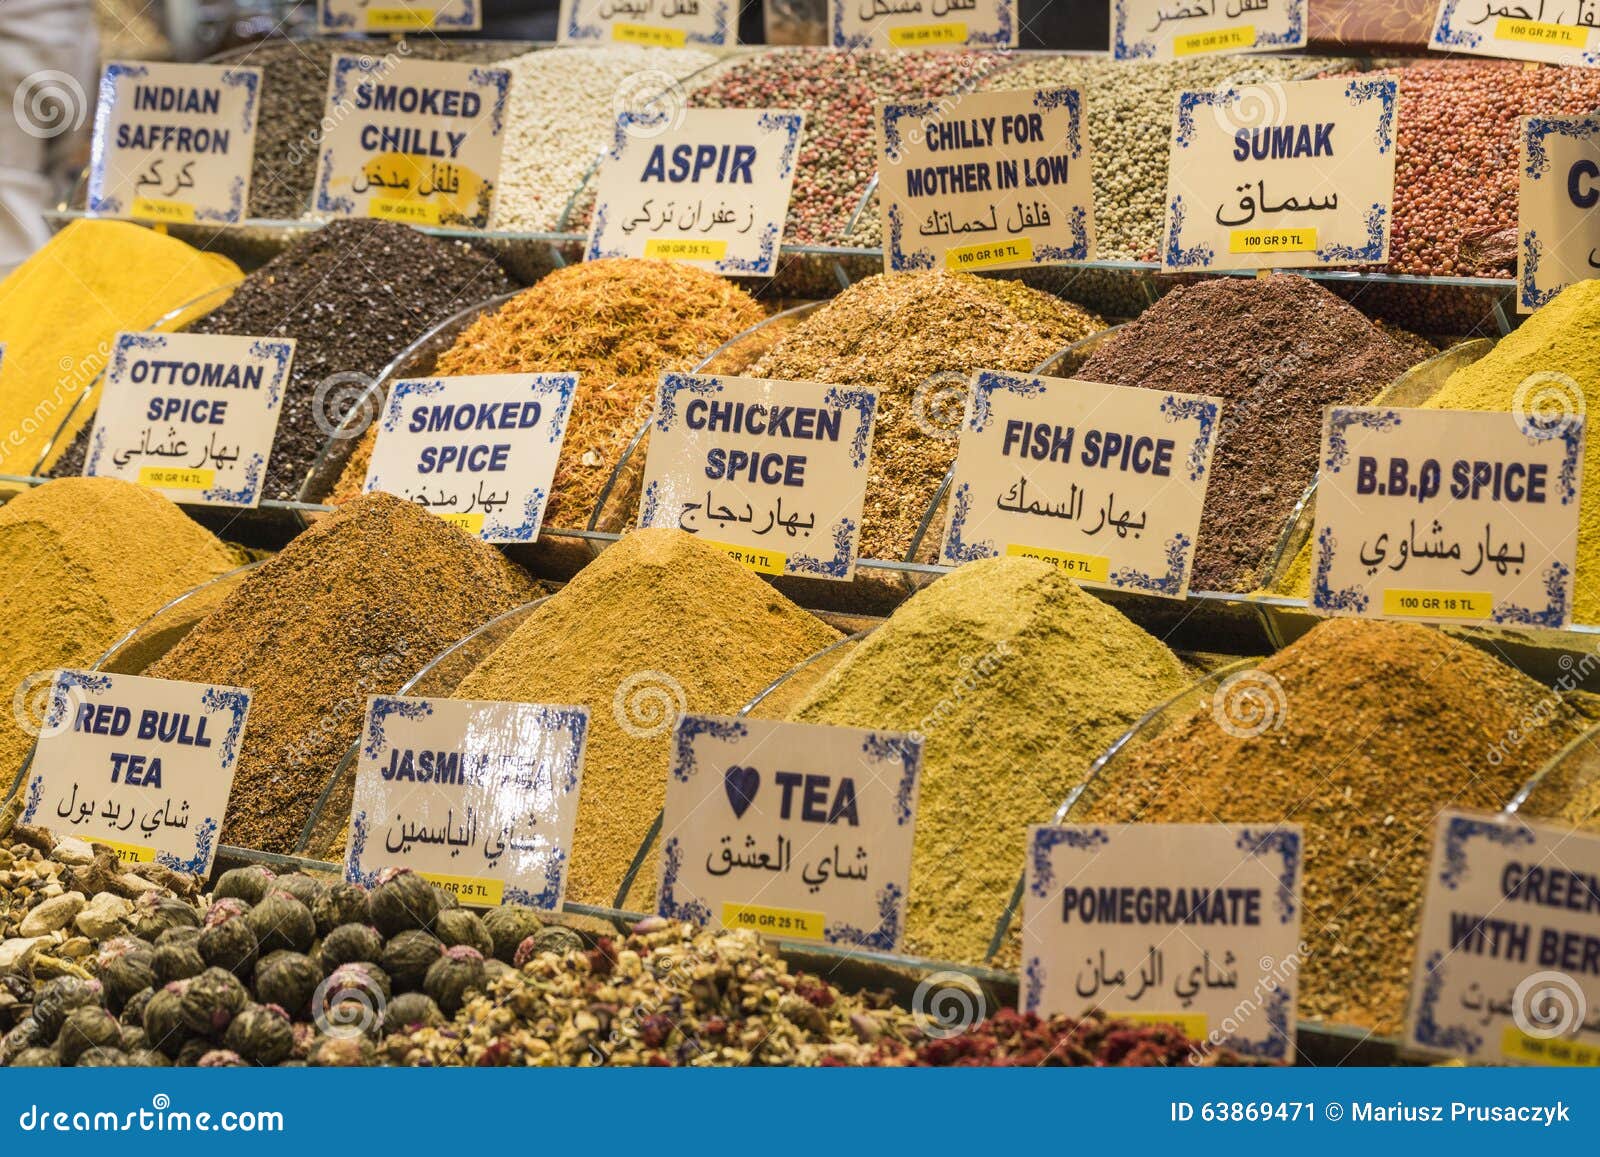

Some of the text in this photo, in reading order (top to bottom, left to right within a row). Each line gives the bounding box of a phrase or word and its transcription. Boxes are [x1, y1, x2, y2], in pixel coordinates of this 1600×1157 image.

[1186, 39, 1200, 49] 100
[1203, 37, 1216, 46] GR
[1231, 33, 1242, 43] TL
[1510, 25, 1526, 35] 100
[1529, 27, 1543, 38] GR
[1560, 31, 1572, 41] TL
[134, 85, 220, 114] INDIAN
[356, 83, 481, 119] SMOKED
[117, 124, 229, 155] SAFFRON
[361, 124, 466, 158] CHILLY
[926, 112, 1044, 152] CHILLY FOR
[1233, 122, 1336, 162] SUMAK
[135, 159, 195, 196] كركم
[352, 163, 459, 196] فلفل مدخن
[640, 144, 757, 184] ASPIR
[906, 155, 1069, 197] MOTHER IN LOW
[621, 200, 675, 235] تركي
[919, 201, 1051, 236] فلفل لحماتك
[1215, 179, 1338, 227] سماق
[656, 244, 671, 254] 100
[673, 244, 686, 254] GR
[701, 246, 712, 255] TL
[958, 246, 1019, 263] 100 GR 18 TL
[1244, 235, 1303, 246] 100 GR 9 TL
[130, 359, 264, 390] OTTOMAN
[147, 396, 228, 425] SPICE
[408, 401, 542, 433] SMOKED
[685, 398, 842, 442] CHICKEN
[112, 426, 240, 470] بهار عثماني
[417, 444, 511, 474] SPICE
[1002, 419, 1175, 477] FISH SPICE
[150, 472, 163, 482] 100
[165, 473, 178, 483] GR
[192, 475, 201, 484] TL
[704, 447, 808, 488] SPICE
[1450, 459, 1548, 504] SPICE
[456, 480, 509, 514] بهار
[679, 491, 815, 537] بهار دجاج
[996, 476, 1147, 539] بهار السمك
[460, 519, 470, 528] TL
[745, 553, 756, 564] 14
[759, 556, 771, 567] TL
[1062, 559, 1075, 570] 16
[1078, 561, 1091, 572] TL
[1359, 519, 1525, 577] بهار مشاوي
[1400, 597, 1474, 611] 100 GR 18 TL
[74, 702, 212, 748] RED BULL
[110, 752, 162, 789] TEA
[57, 782, 190, 839] شاي ريد بول
[775, 771, 860, 826] TEA
[385, 806, 477, 858] الياسمين
[129, 851, 140, 863] TL
[706, 834, 868, 894] شاي العشق
[462, 884, 473, 895] 35
[476, 885, 488, 896] TL
[1063, 885, 1262, 926] POMEGRANATE
[738, 912, 808, 931] 100 GR 25 TL
[1450, 911, 1530, 964] WITH
[1076, 945, 1238, 1008] شاي الرمان
